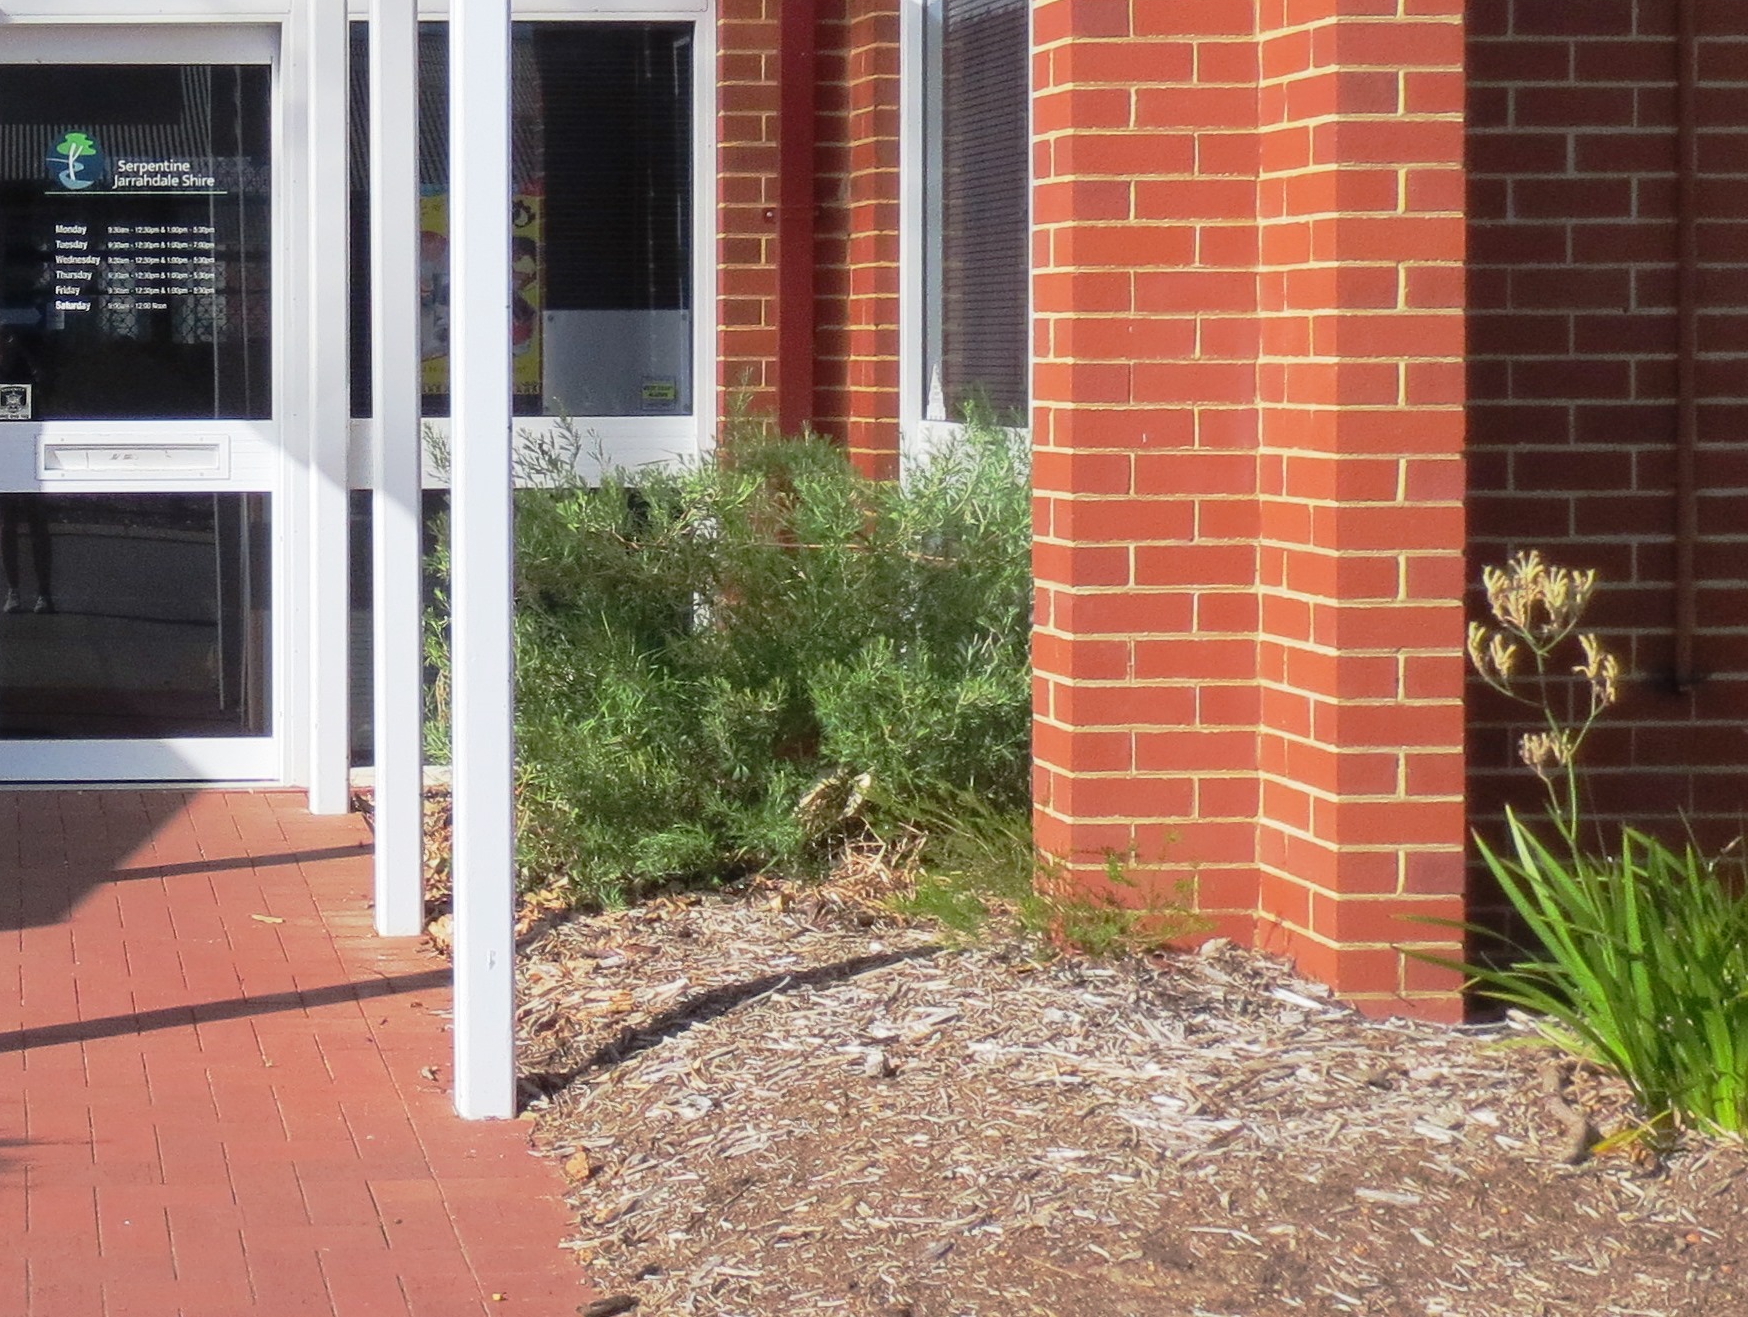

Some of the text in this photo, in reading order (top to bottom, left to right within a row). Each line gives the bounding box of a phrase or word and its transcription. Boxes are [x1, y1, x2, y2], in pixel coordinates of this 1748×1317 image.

[117, 159, 191, 176] Serpentine
[112, 174, 215, 190] Jarrahdale Shire
[55, 225, 87, 235] Monday
[55, 240, 88, 250] Tuesday
[55, 255, 101, 266] Wednesday
[55, 271, 92, 281] Thursday
[55, 286, 80, 296] Friday
[55, 300, 91, 311] Saturday
